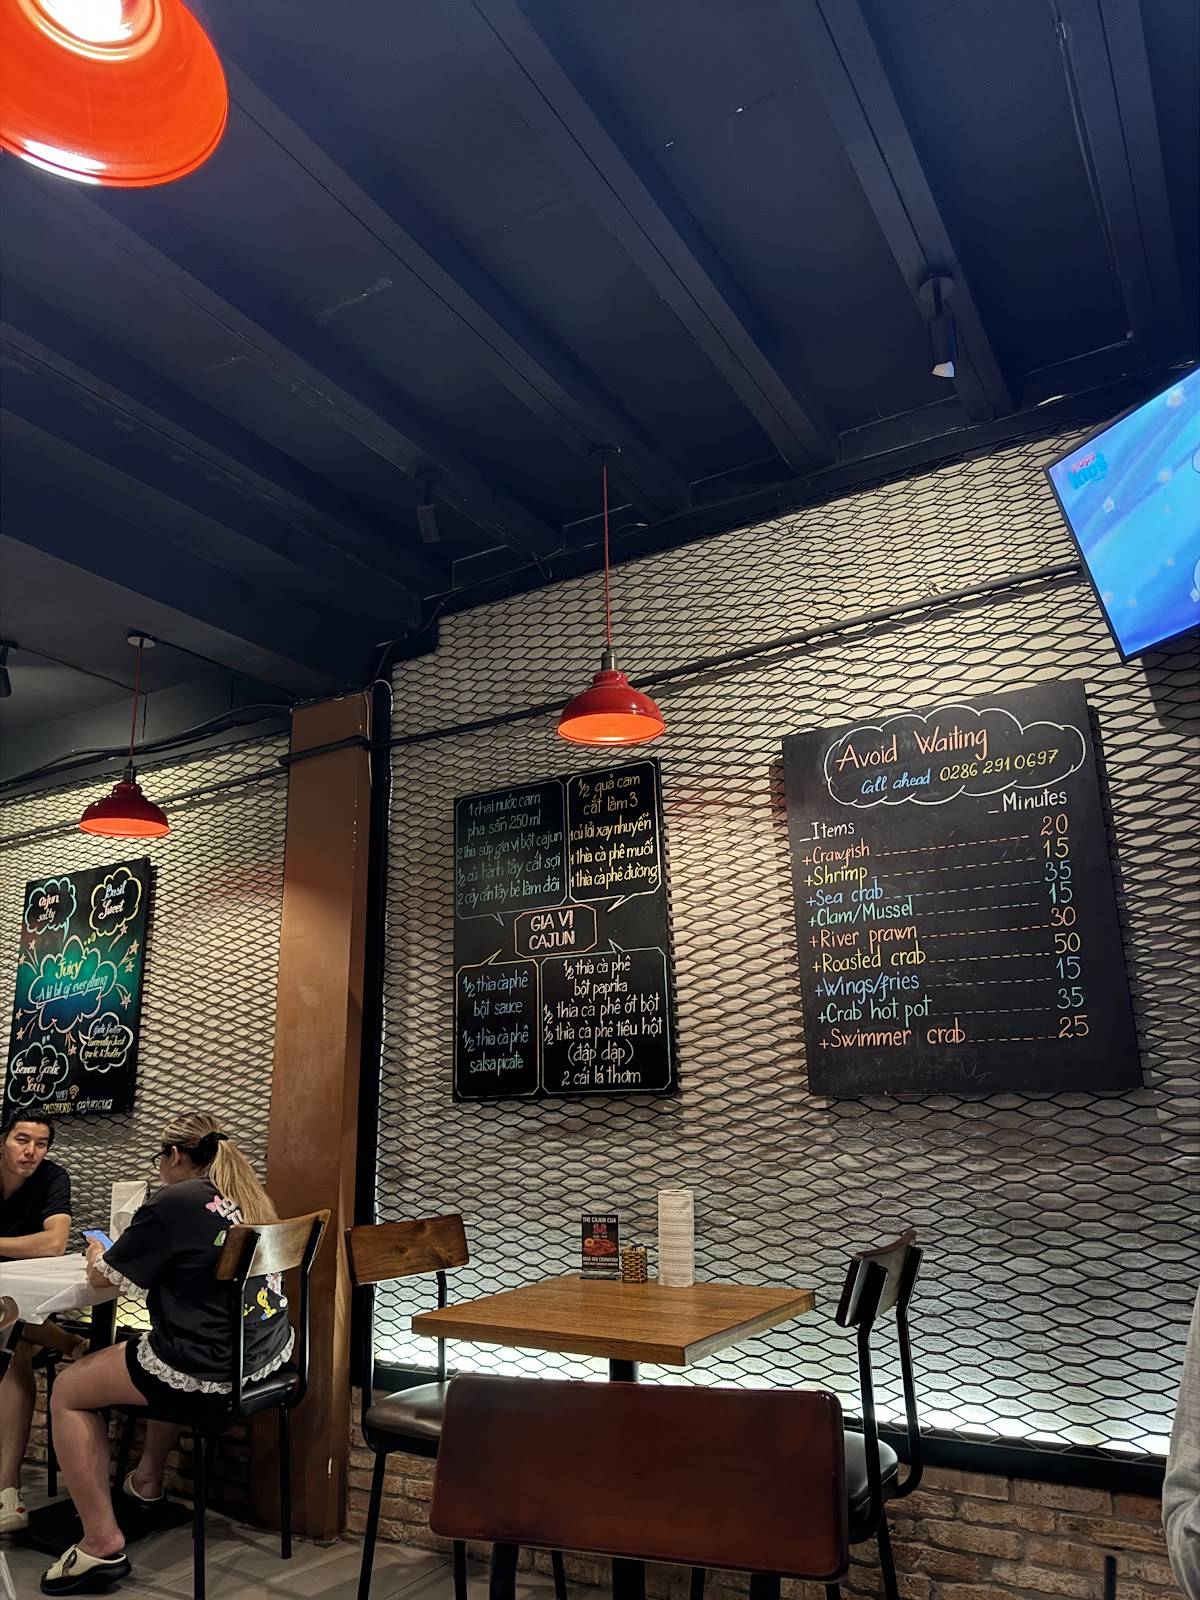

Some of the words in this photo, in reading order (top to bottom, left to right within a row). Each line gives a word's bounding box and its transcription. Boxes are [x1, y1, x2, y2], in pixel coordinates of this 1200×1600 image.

[836, 735, 897, 771] Avoid
[914, 726, 989, 761] Waiting
[893, 768, 931, 790] ahead
[940, 762, 978, 782] 0286
[1014, 749, 1059, 770] 0697
[595, 773, 614, 798] quả
[617, 775, 640, 788] cam
[469, 803, 473, 816] 1
[474, 800, 494, 816] chai
[496, 793, 517, 811] nước
[519, 793, 541, 808] cam
[583, 794, 602, 815] cắt
[607, 795, 628, 812] làm
[629, 791, 639, 808] 3
[467, 820, 485, 842] pha
[509, 813, 529, 830] 250
[529, 809, 541, 826] ml
[596, 825, 613, 841] xay
[1041, 814, 1068, 837] 20
[479, 841, 494, 862] súp
[494, 841, 509, 860] gia
[511, 837, 520, 853] vị
[520, 832, 535, 850] bột
[536, 830, 563, 850] cajun
[576, 846, 593, 864] thìa
[595, 845, 606, 862] cà
[609, 842, 625, 867] phê
[626, 836, 654, 858] muối
[1043, 837, 1069, 858] 15
[507, 858, 523, 879] tây
[526, 851, 542, 872] cắt
[544, 852, 561, 870] sợi
[576, 868, 593, 887] thìa
[594, 866, 605, 885] cà
[606, 866, 624, 890] phê
[624, 861, 659, 884] đường
[458, 893, 464, 905] 2
[522, 879, 541, 896] làm
[543, 875, 560, 893] đôi
[851, 878, 883, 902] crab
[1045, 860, 1072, 882] 35
[1049, 881, 1073, 904] 15
[530, 913, 554, 932] GIA
[558, 910, 574, 929] VỊ
[869, 925, 917, 954] prawn
[1051, 906, 1076, 927] 30
[529, 930, 575, 950] CAJUN
[891, 940, 926, 966] crab
[1054, 932, 1081, 954] 50
[575, 959, 594, 975] thìa
[596, 958, 608, 973] cà
[611, 954, 631, 979] phê
[1055, 956, 1081, 979] 15
[476, 974, 496, 992] thìa
[497, 972, 509, 990] cà
[509, 969, 529, 996] phê
[574, 978, 590, 998] bột
[593, 974, 628, 1001] paprika
[474, 998, 491, 1019] bột
[494, 1001, 523, 1016] sauce
[556, 998, 578, 1018] thìa
[581, 998, 595, 1017] cà
[600, 996, 621, 1023] phê
[624, 994, 638, 1014] ớt
[640, 992, 660, 1015] bột
[870, 999, 899, 1020] hot
[904, 994, 933, 1028] pot
[1057, 986, 1085, 1010] 35
[476, 1027, 496, 1047] thìa
[497, 1026, 509, 1045] cà
[510, 1022, 529, 1053] phê
[555, 1021, 575, 1041] thìa
[578, 1020, 591, 1039] cà
[595, 1020, 613, 1049] phê
[616, 1019, 638, 1037] tiêu
[641, 1016, 663, 1037] hột
[927, 1017, 966, 1044] crab
[1059, 1014, 1089, 1039] 25
[469, 1051, 496, 1074] salsa
[497, 1050, 524, 1077] picate
[561, 1071, 570, 1086] 2
[573, 1066, 590, 1085] cái
[594, 1065, 604, 1084] lá
[606, 1064, 641, 1083] thơm
